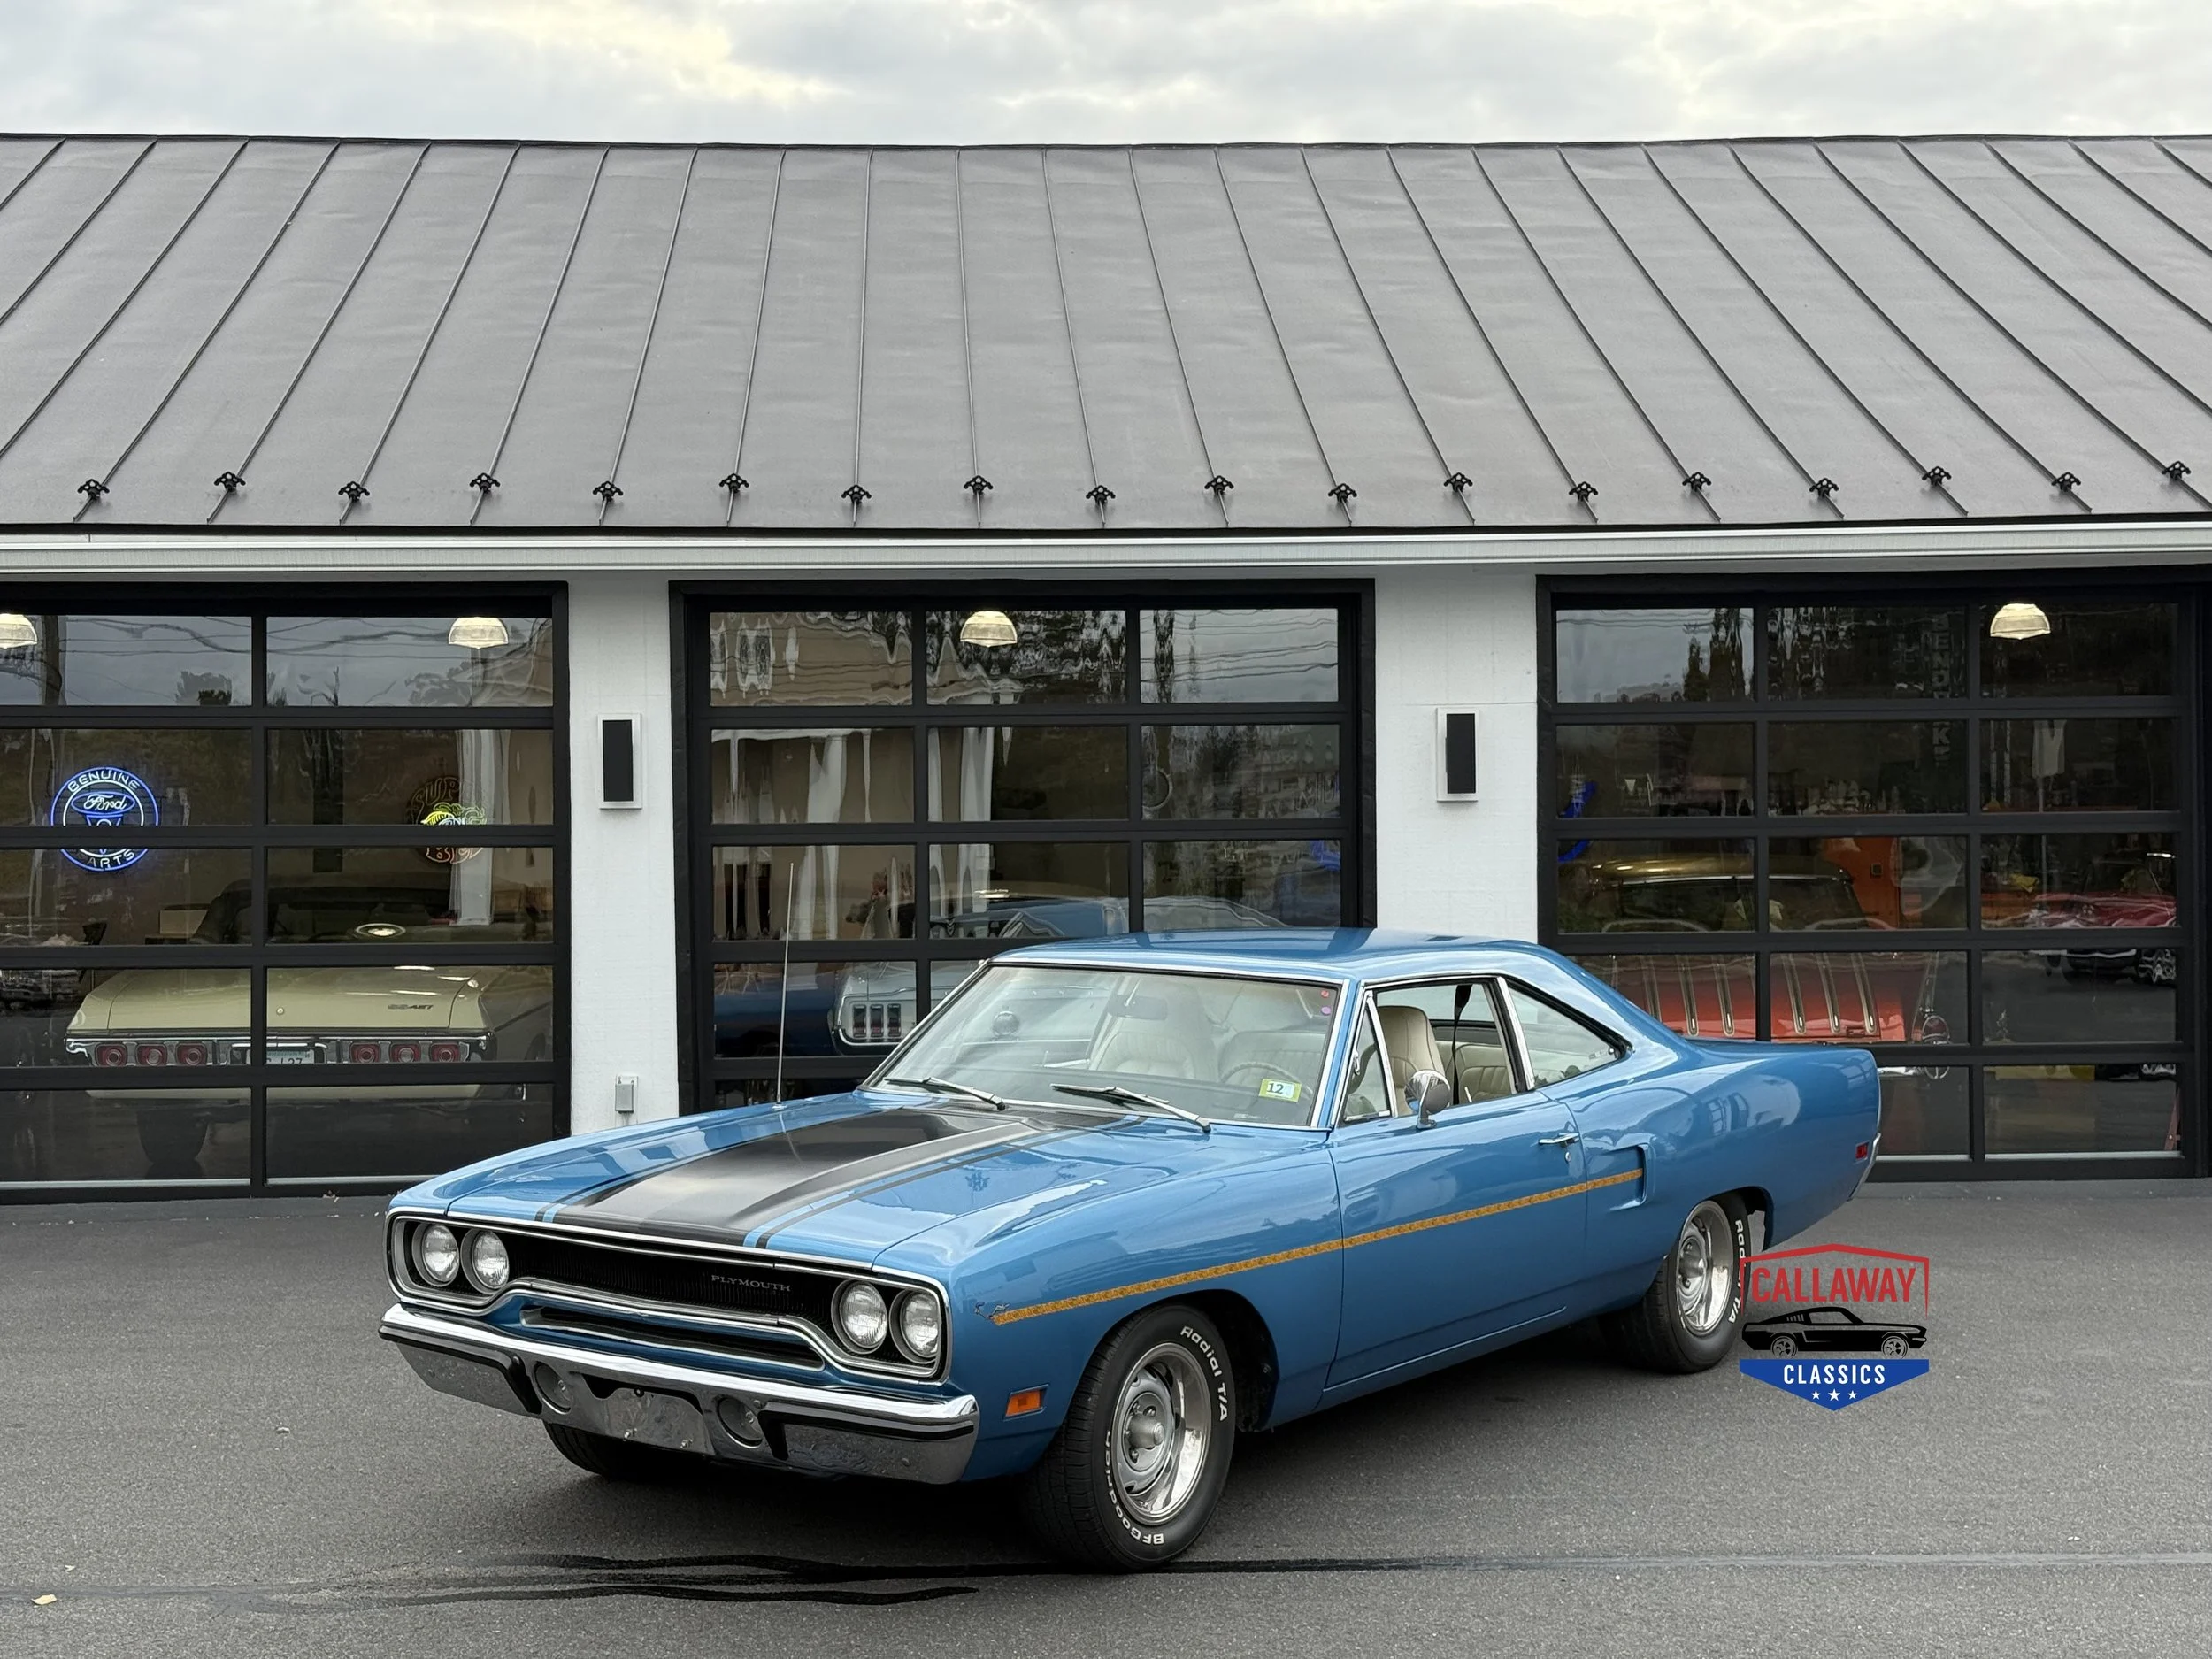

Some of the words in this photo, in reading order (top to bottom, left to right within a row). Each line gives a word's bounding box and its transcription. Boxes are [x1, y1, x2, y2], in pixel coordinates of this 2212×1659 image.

[67, 769, 141, 793] GENUINE
[83, 793, 128, 811] Ford
[76, 848, 135, 869] ARTS
[1266, 1081, 1286, 1095] 12
[710, 1274, 791, 1292] PLYMOUTH
[1179, 1325, 1223, 1378] Radial
[1217, 1381, 1228, 1422] T/A
[1105, 1430, 1164, 1545] BFGoodrich
